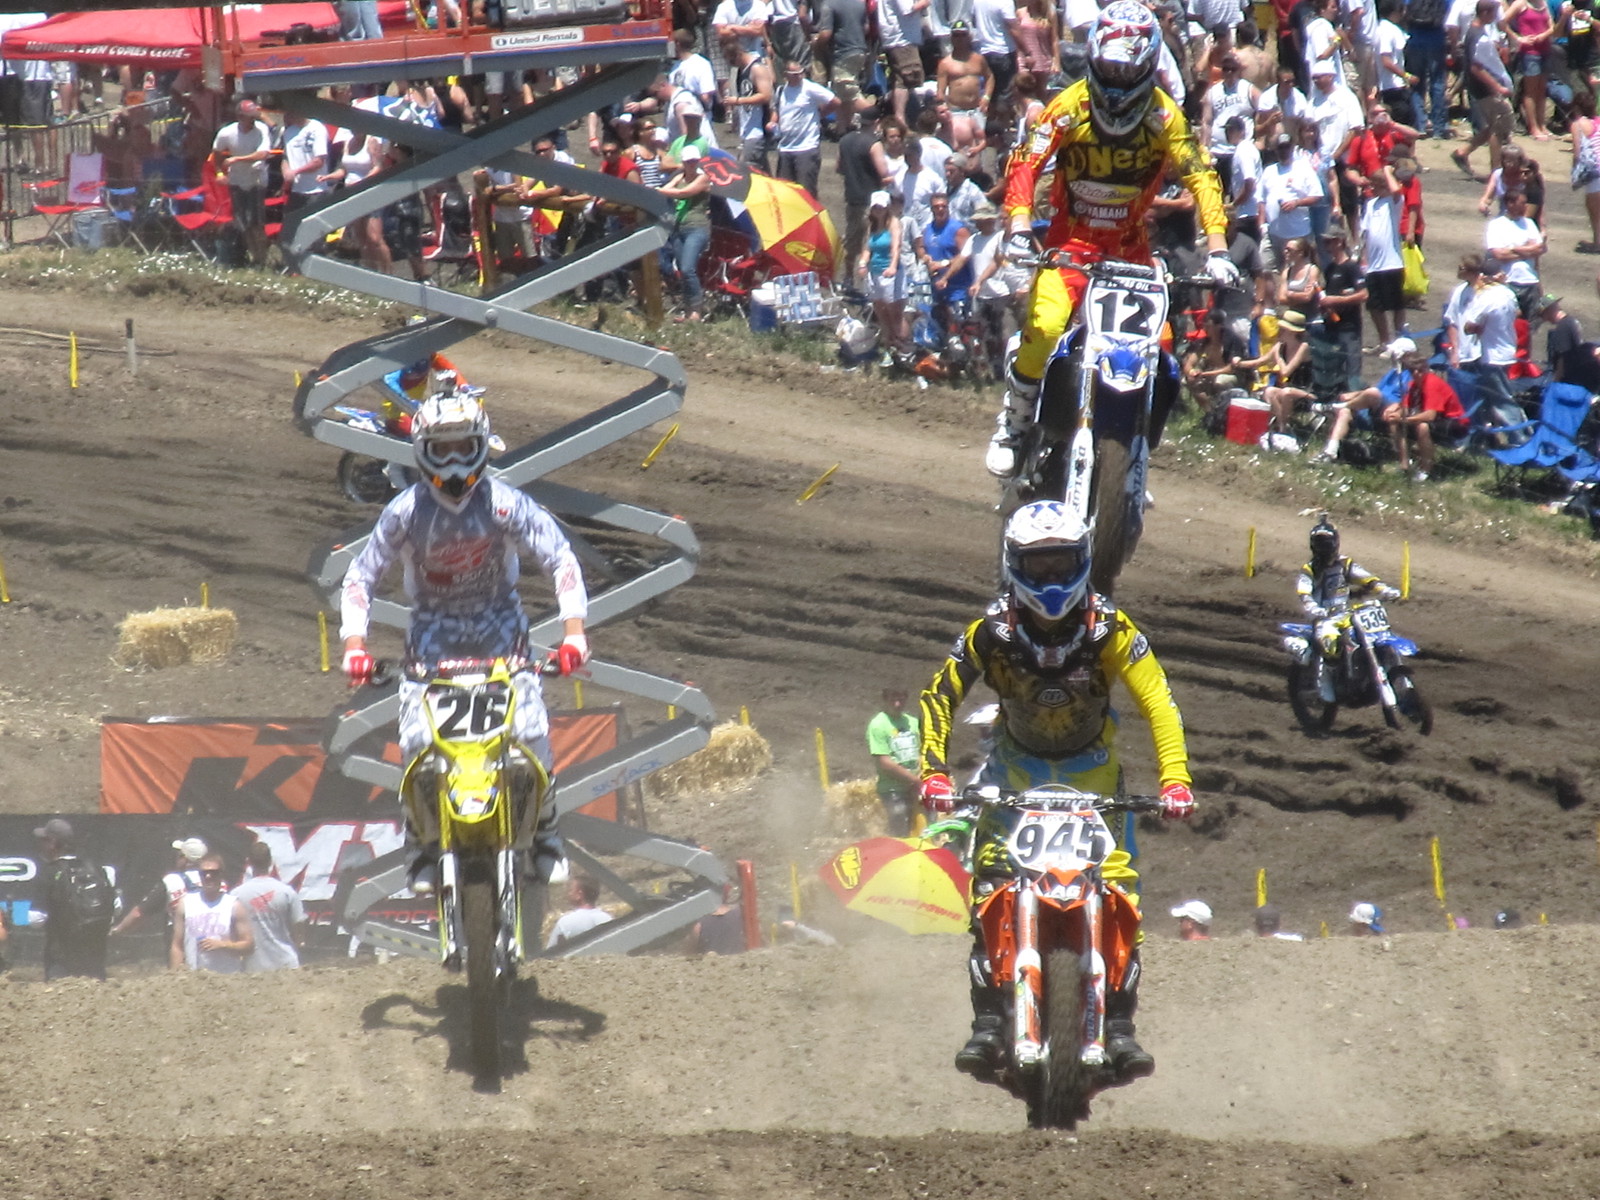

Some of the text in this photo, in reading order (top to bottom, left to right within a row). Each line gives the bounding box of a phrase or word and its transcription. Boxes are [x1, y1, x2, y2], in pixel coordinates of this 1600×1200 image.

[509, 31, 578, 46] United Rentals
[108, 45, 147, 57] COMES
[1087, 206, 1128, 219] YAMAHA
[1094, 291, 1156, 338] 12
[1360, 610, 1388, 631] 539
[437, 694, 507, 739] 26
[1016, 822, 1107, 864] 945
